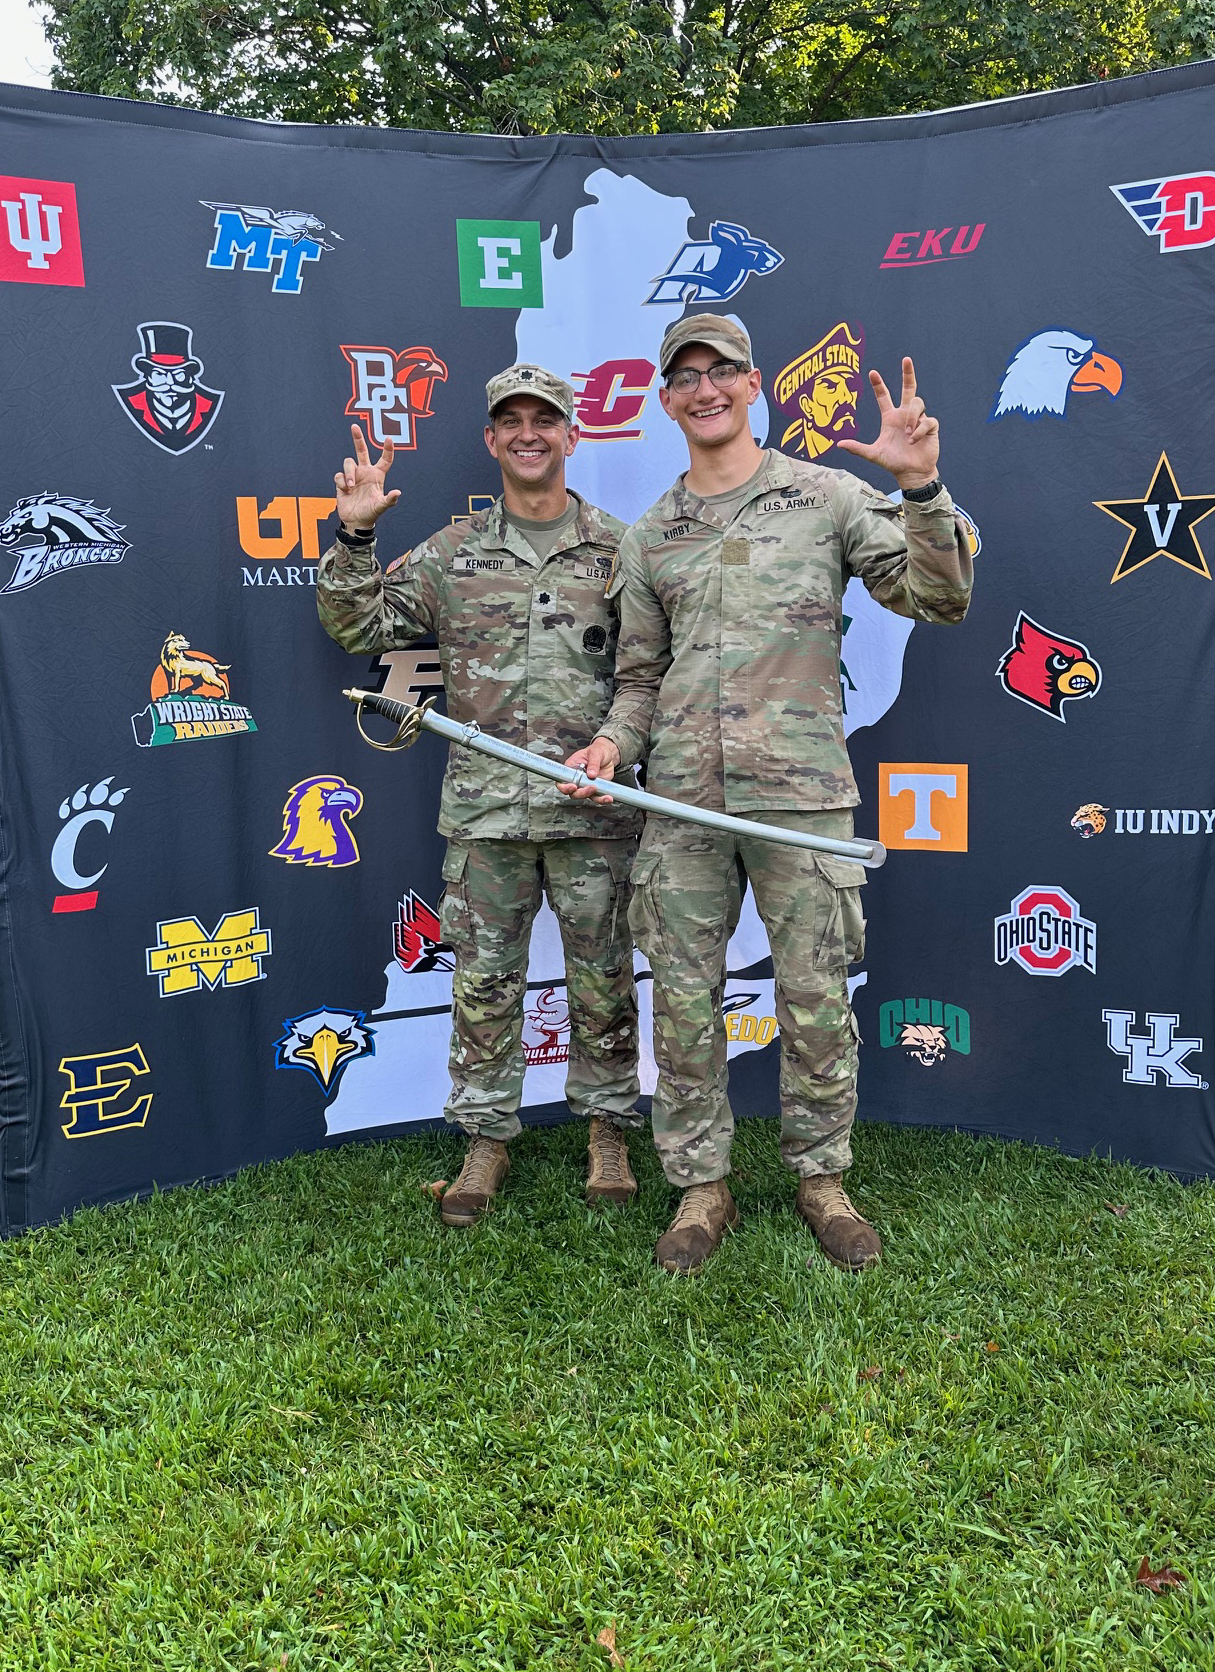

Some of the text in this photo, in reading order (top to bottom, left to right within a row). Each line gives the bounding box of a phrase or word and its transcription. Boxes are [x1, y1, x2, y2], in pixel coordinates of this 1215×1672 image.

[206, 209, 322, 294] MT
[477, 237, 523, 290] E
[883, 223, 987, 260] EKU
[349, 351, 411, 444] BG
[571, 358, 658, 430] C
[780, 344, 860, 405] CENTRAL STATE
[763, 497, 816, 512] U.S. ARMY
[1144, 503, 1182, 547] V
[53, 542, 88, 550] WESTERN
[663, 523, 691, 540] KIRBY
[5, 545, 123, 591] BRONCOS
[465, 559, 505, 570] KENNEDY
[155, 701, 253, 723] WRIGHT STATE
[172, 720, 250, 740] RAIDERS
[889, 773, 957, 840] T
[1115, 809, 1215, 835] IU INDY
[51, 809, 115, 889] C
[166, 940, 255, 964] MICHIGAN
[996, 911, 1095, 971] OHIO STATE
[879, 998, 970, 1055] OHIO
[1102, 1009, 1203, 1089] UK
[58, 1043, 153, 1139] E
